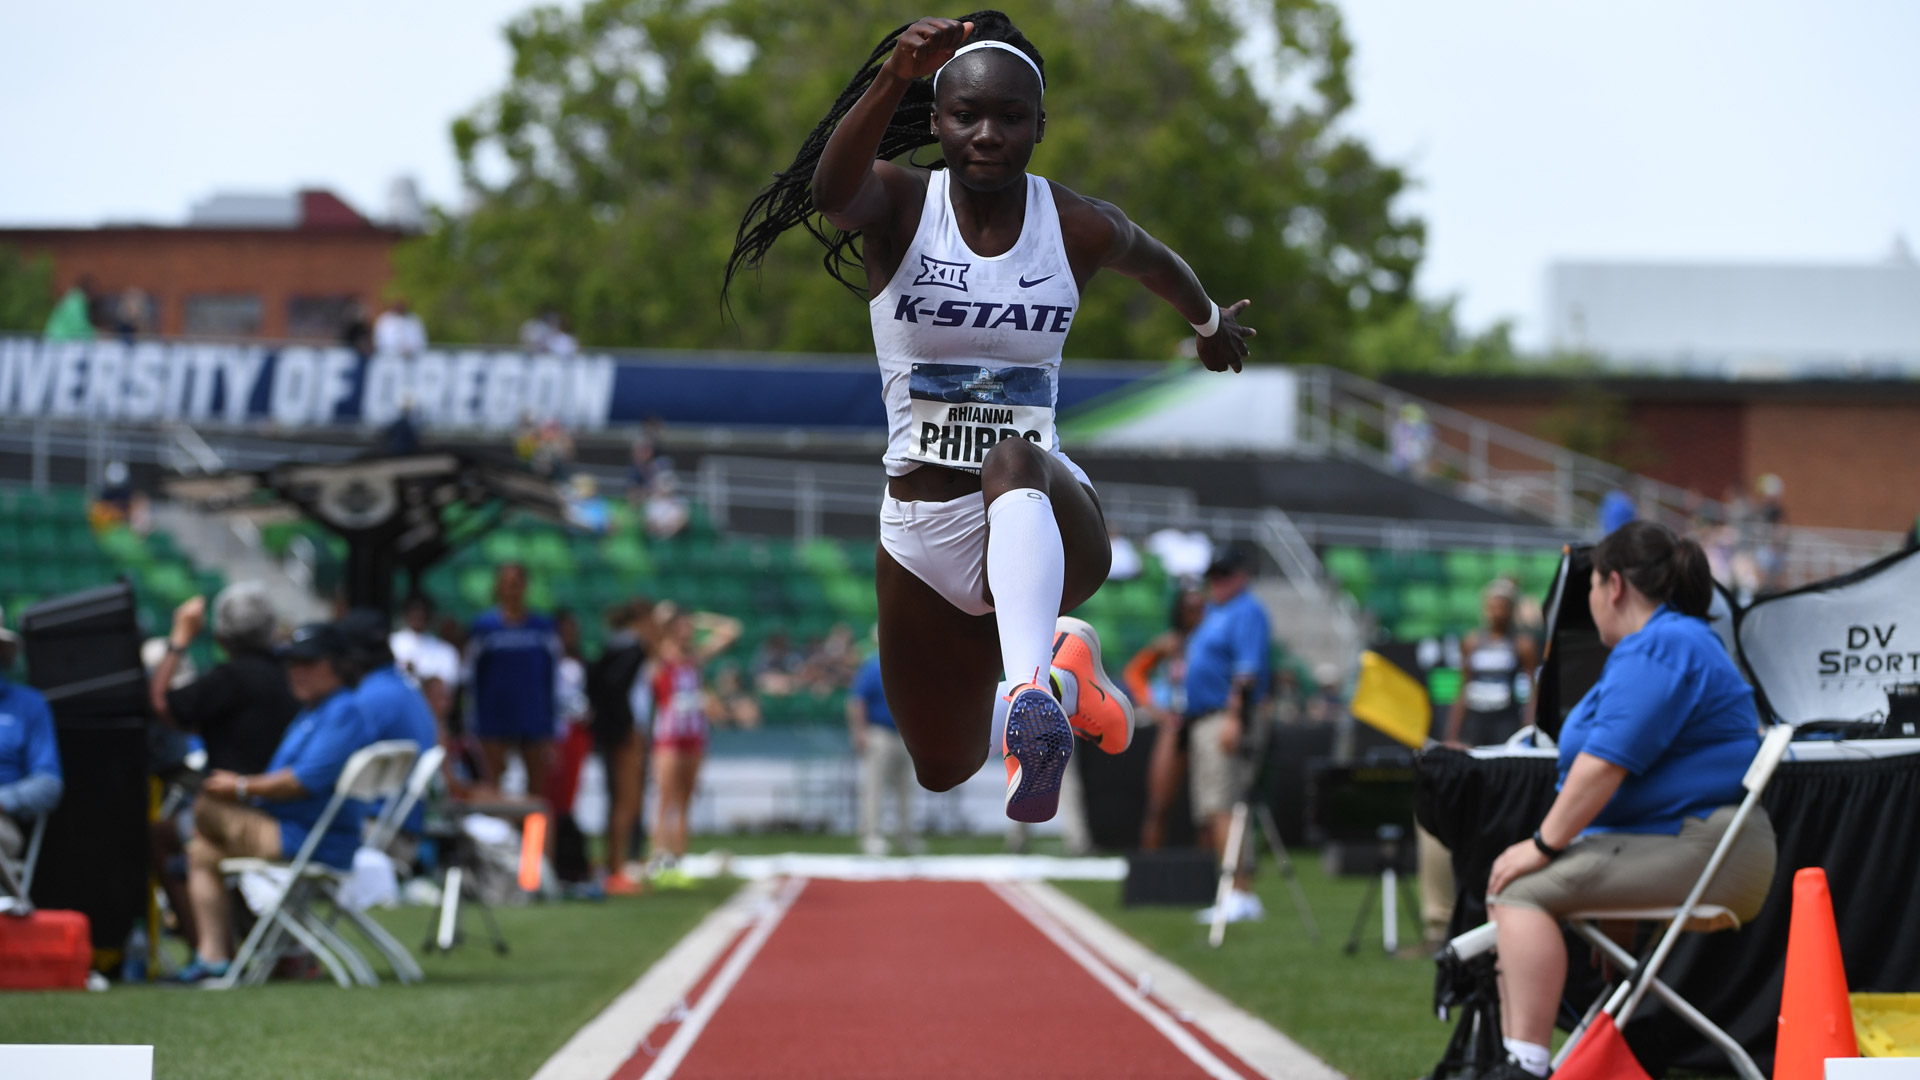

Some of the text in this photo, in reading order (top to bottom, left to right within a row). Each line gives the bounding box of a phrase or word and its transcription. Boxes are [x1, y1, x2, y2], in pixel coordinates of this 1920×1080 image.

[894, 294, 1072, 333] K-STATE
[270, 345, 358, 426] OF
[361, 349, 616, 431] OREGON
[948, 406, 1014, 425] RHIANNA
[1847, 623, 1896, 650] DV
